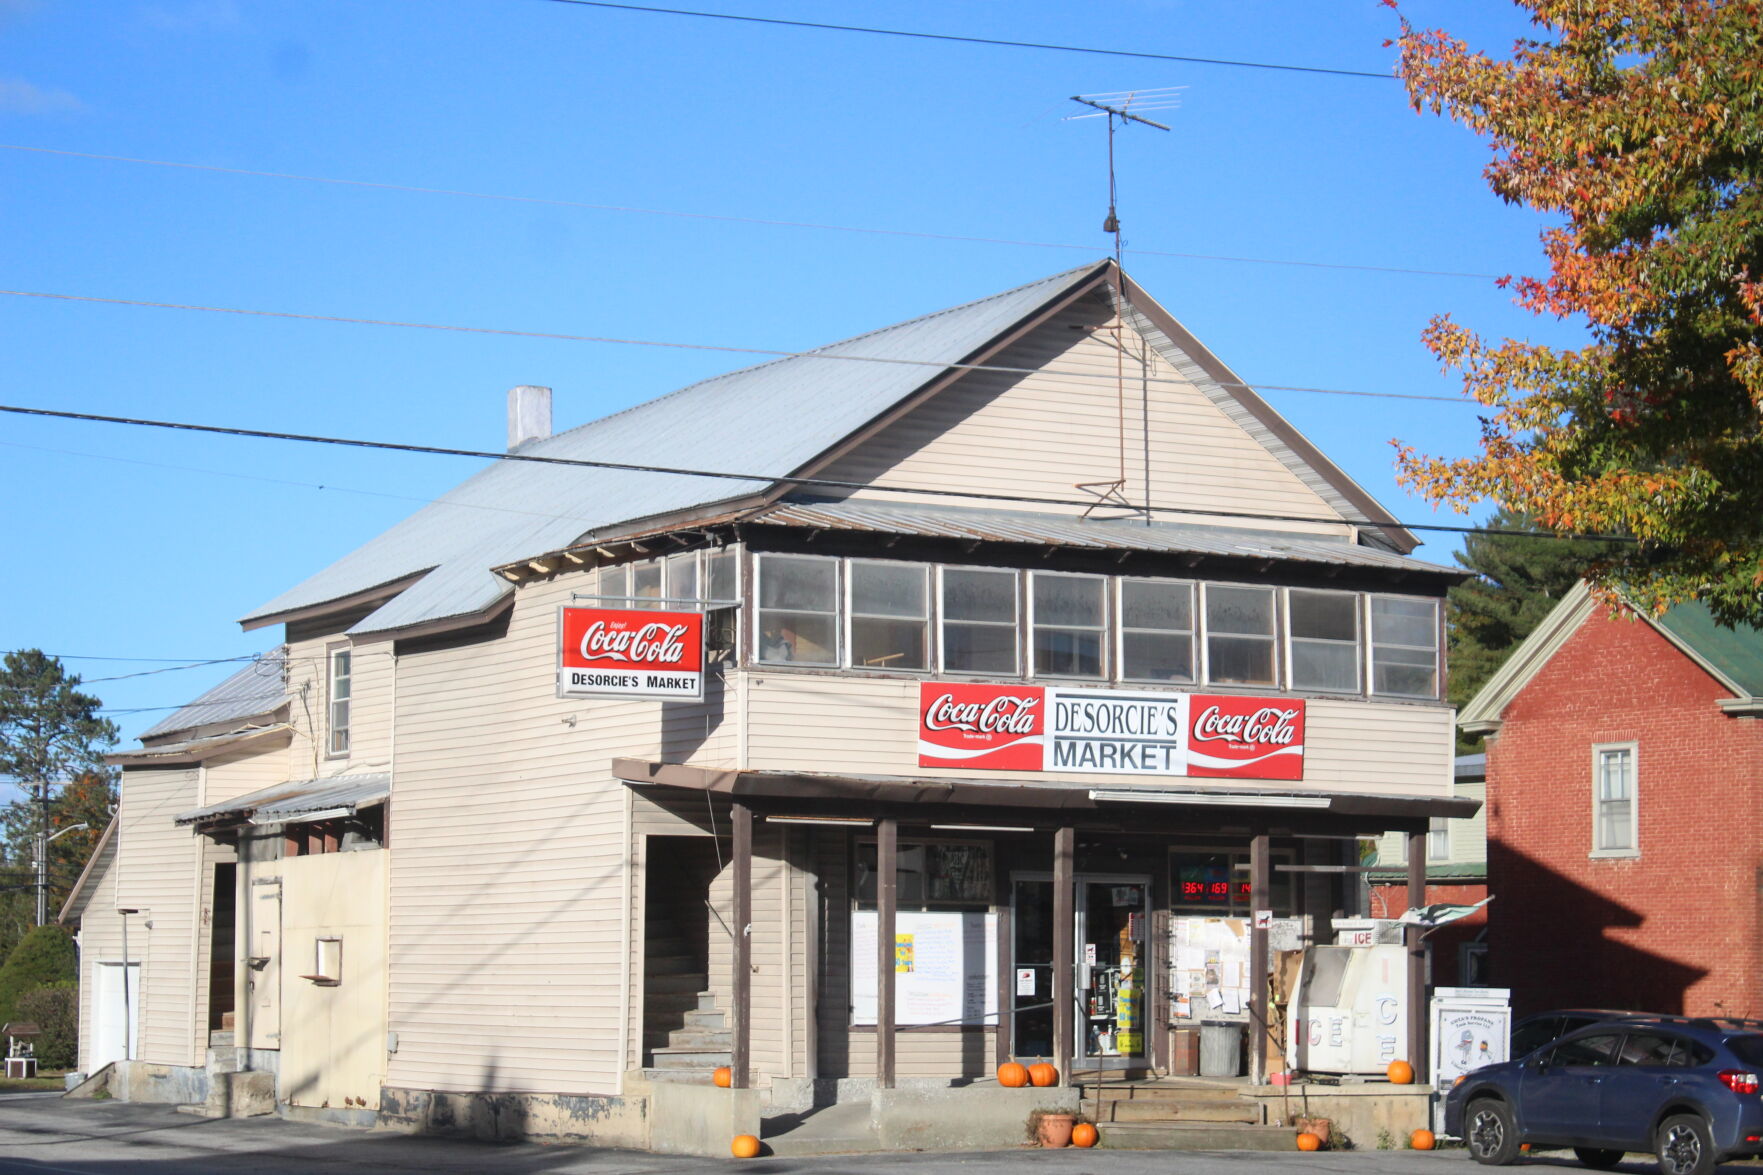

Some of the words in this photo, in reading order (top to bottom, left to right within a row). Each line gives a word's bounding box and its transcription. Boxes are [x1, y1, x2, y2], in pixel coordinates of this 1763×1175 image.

[580, 620, 688, 663] Coca-Cola
[572, 672, 639, 688] DESORCIE'S
[646, 675, 697, 690] MARKET
[925, 693, 1041, 735] Coca-Cola
[1055, 702, 1178, 736] DESORCIE'S
[1193, 705, 1300, 744] Coca-Cola
[1053, 740, 1177, 770] MARKET
[1354, 933, 1372, 944] ICE
